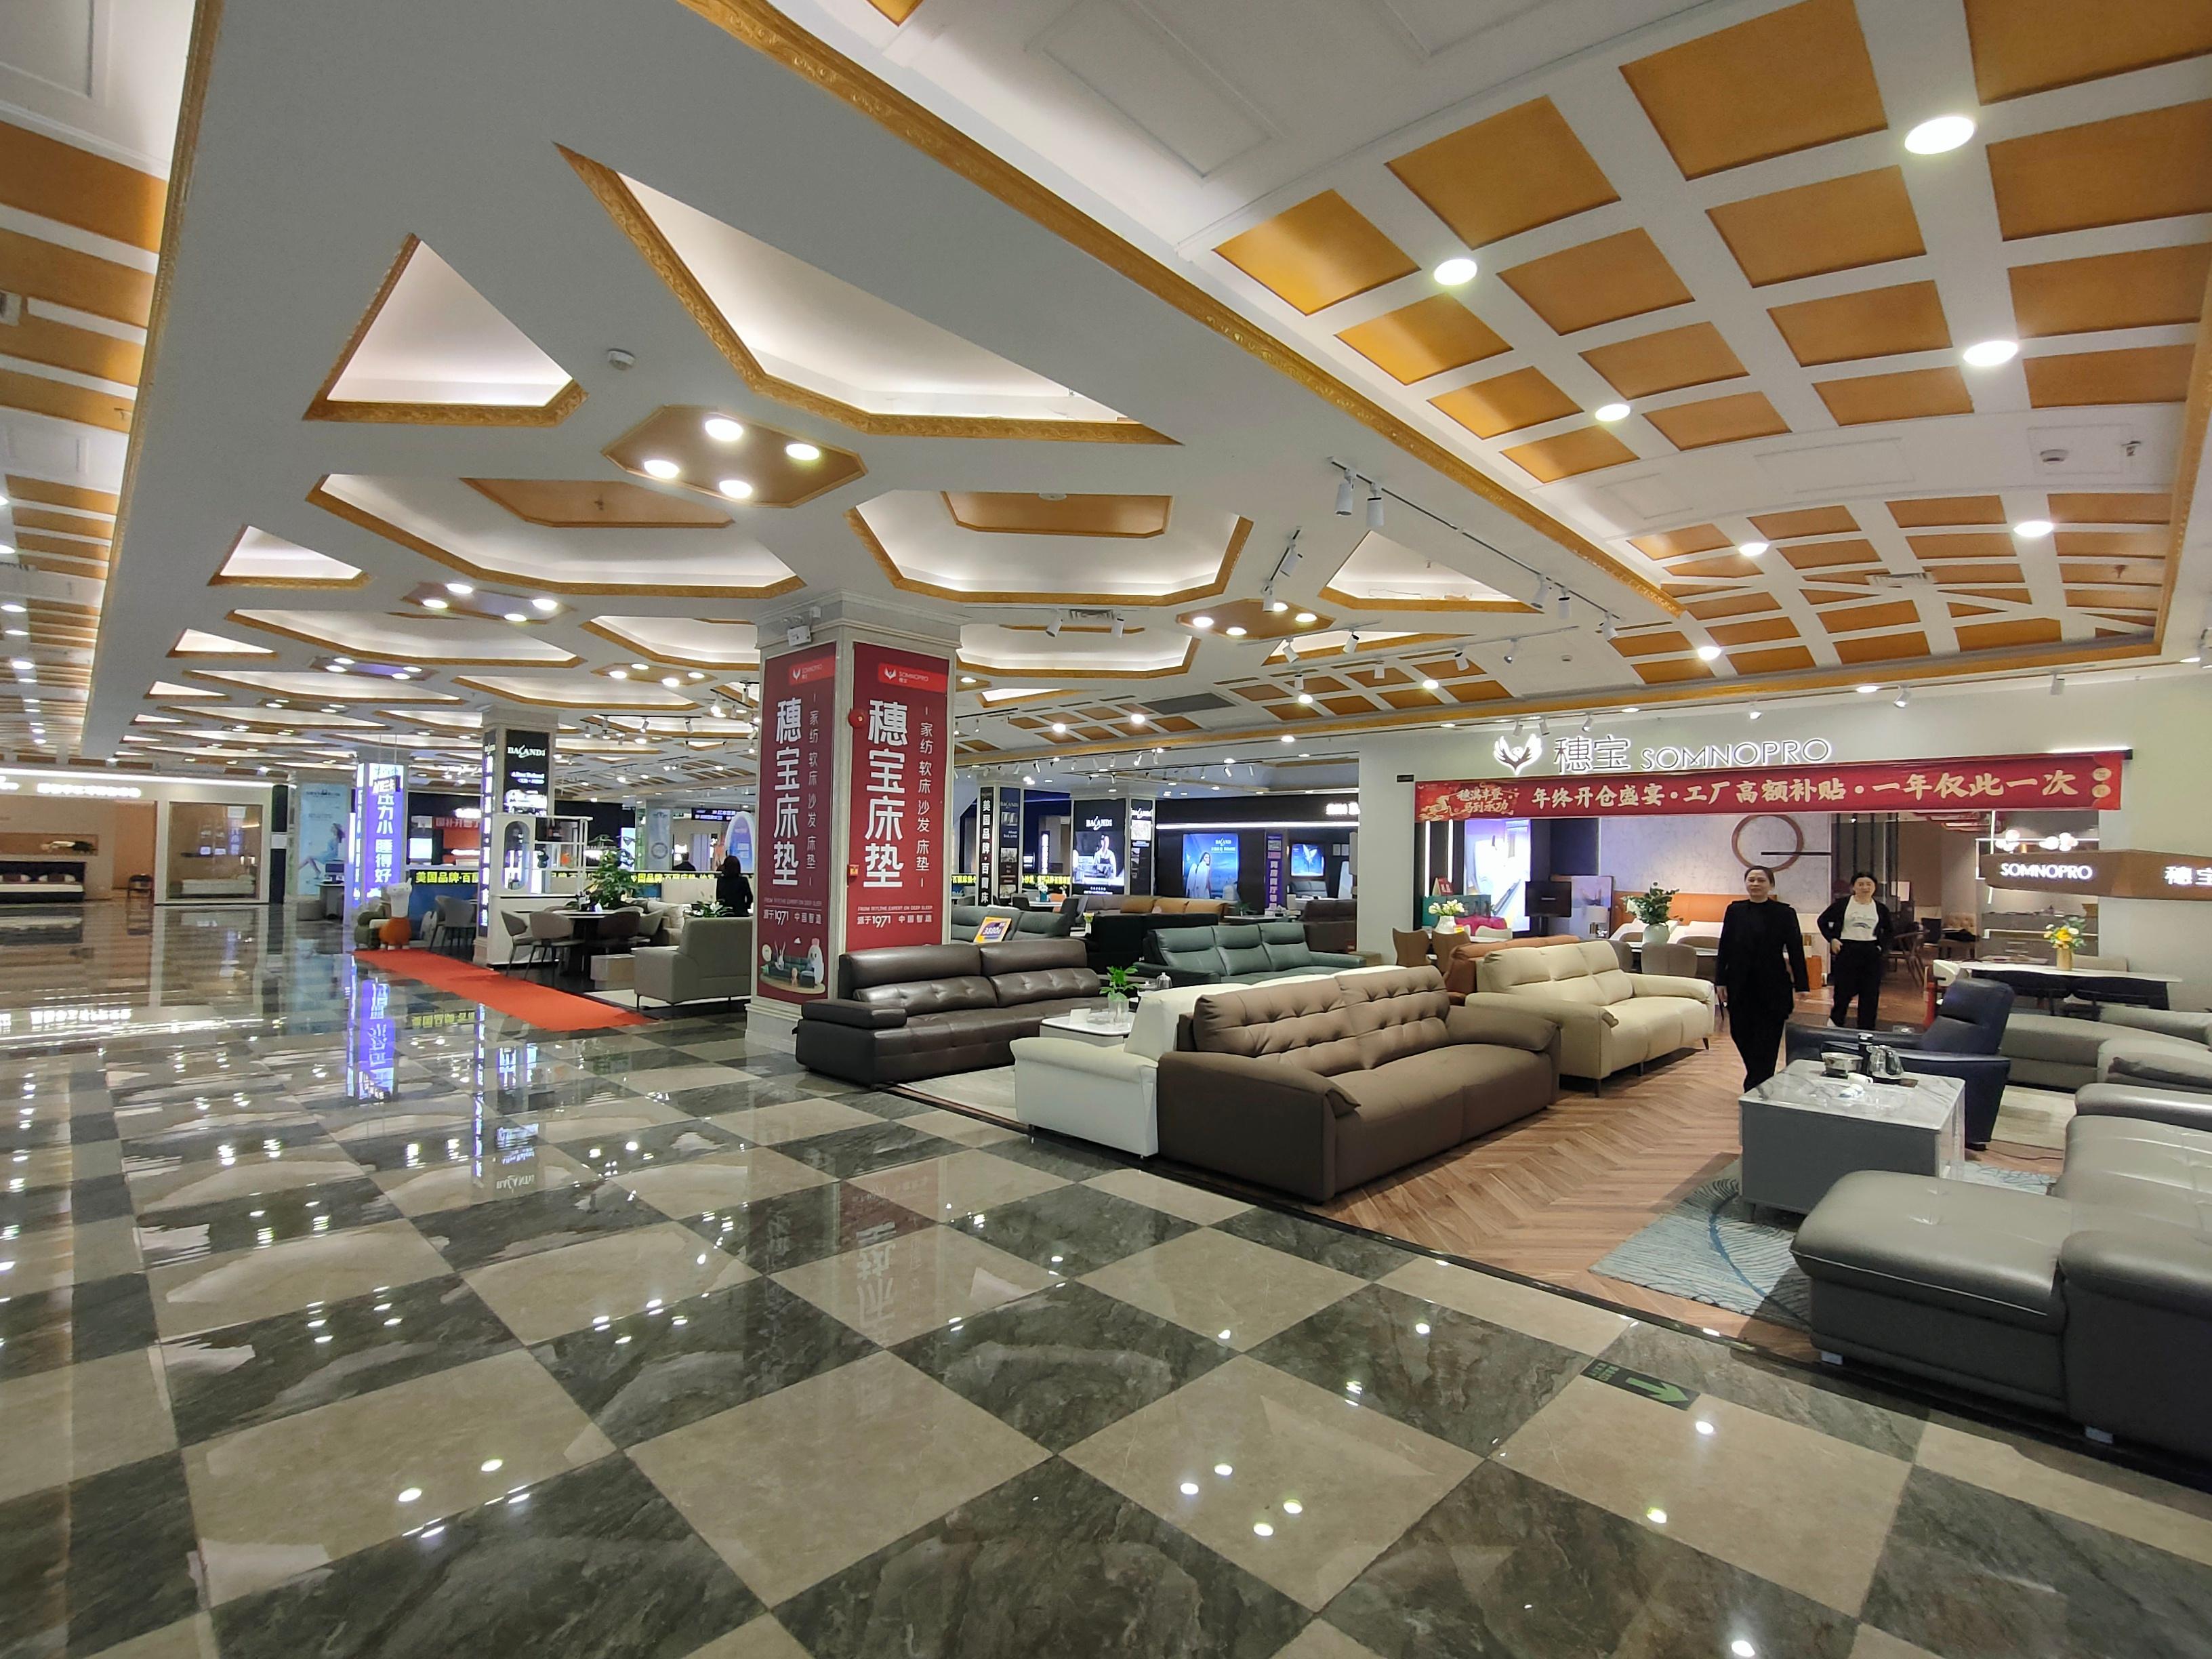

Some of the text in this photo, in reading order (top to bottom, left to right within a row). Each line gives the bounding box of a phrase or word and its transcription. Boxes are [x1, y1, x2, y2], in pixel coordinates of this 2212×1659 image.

[773, 697, 802, 886] 穗宝床垫
[863, 699, 908, 888] 穗宝床垫
[1553, 736, 1832, 775] 穗宝 SOMNOPRO
[2000, 863, 2093, 880] SOMNOPRO
